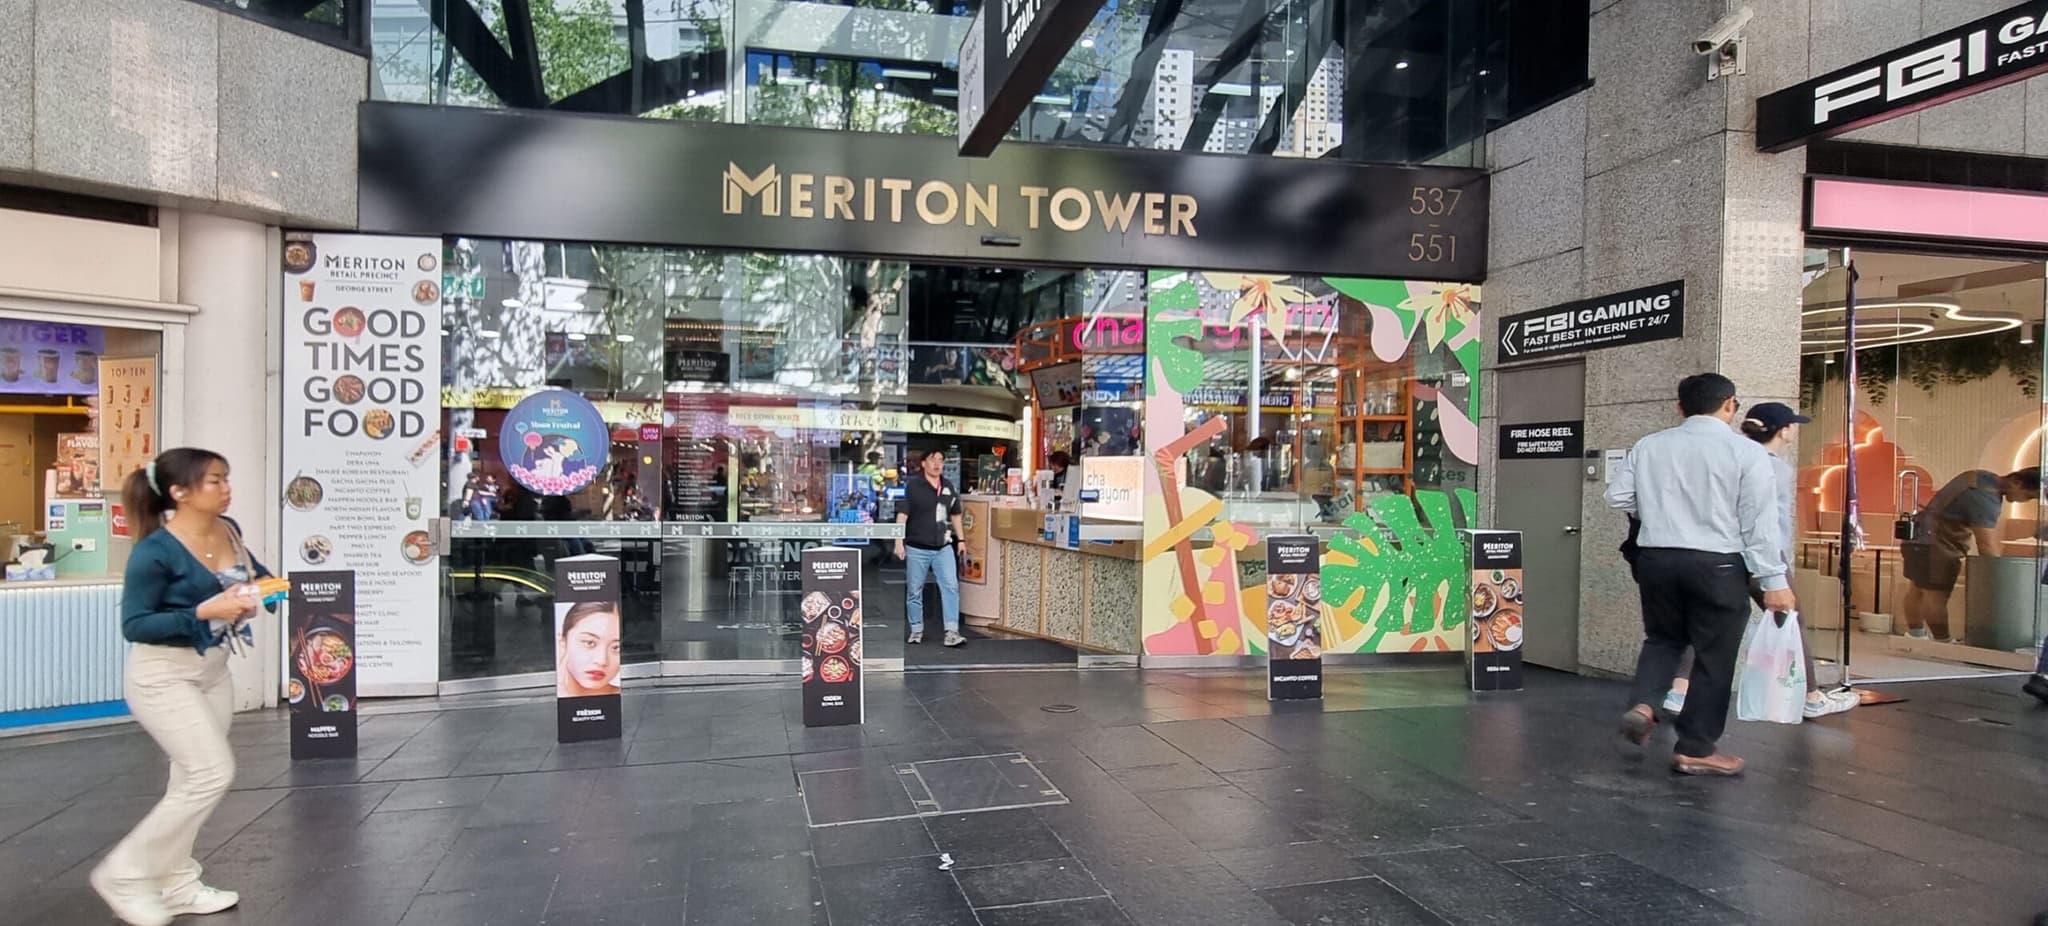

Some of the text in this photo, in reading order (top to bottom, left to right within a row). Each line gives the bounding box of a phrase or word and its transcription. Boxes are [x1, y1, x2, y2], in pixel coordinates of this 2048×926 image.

[1814, 29, 1987, 125] FBI
[723, 161, 1199, 237] MERITON TOWER
[1409, 187, 1463, 215] 537
[1408, 233, 1456, 262] 551
[324, 254, 405, 271] MERITON
[330, 271, 399, 280] RETAIL PRECINCT
[303, 306, 425, 338] GOOD
[1523, 294, 1671, 337] FBI GAMING
[1523, 314, 1670, 347] FAST BEST INTERNET 24/7
[304, 341, 424, 372] TIMES
[111, 367, 146, 377] TOP TEN
[303, 374, 424, 405] GOOD
[304, 408, 424, 439] FOOD
[1511, 427, 1574, 438] FIRE HOSE REEL
[1087, 468, 1106, 486] cha
[676, 513, 705, 521] MERITON
[1278, 546, 1310, 554] MERITON
[1483, 542, 1513, 550] MERITON
[812, 561, 849, 570] MERITON
[567, 571, 606, 581] MERITON
[301, 582, 342, 592] MERITON
